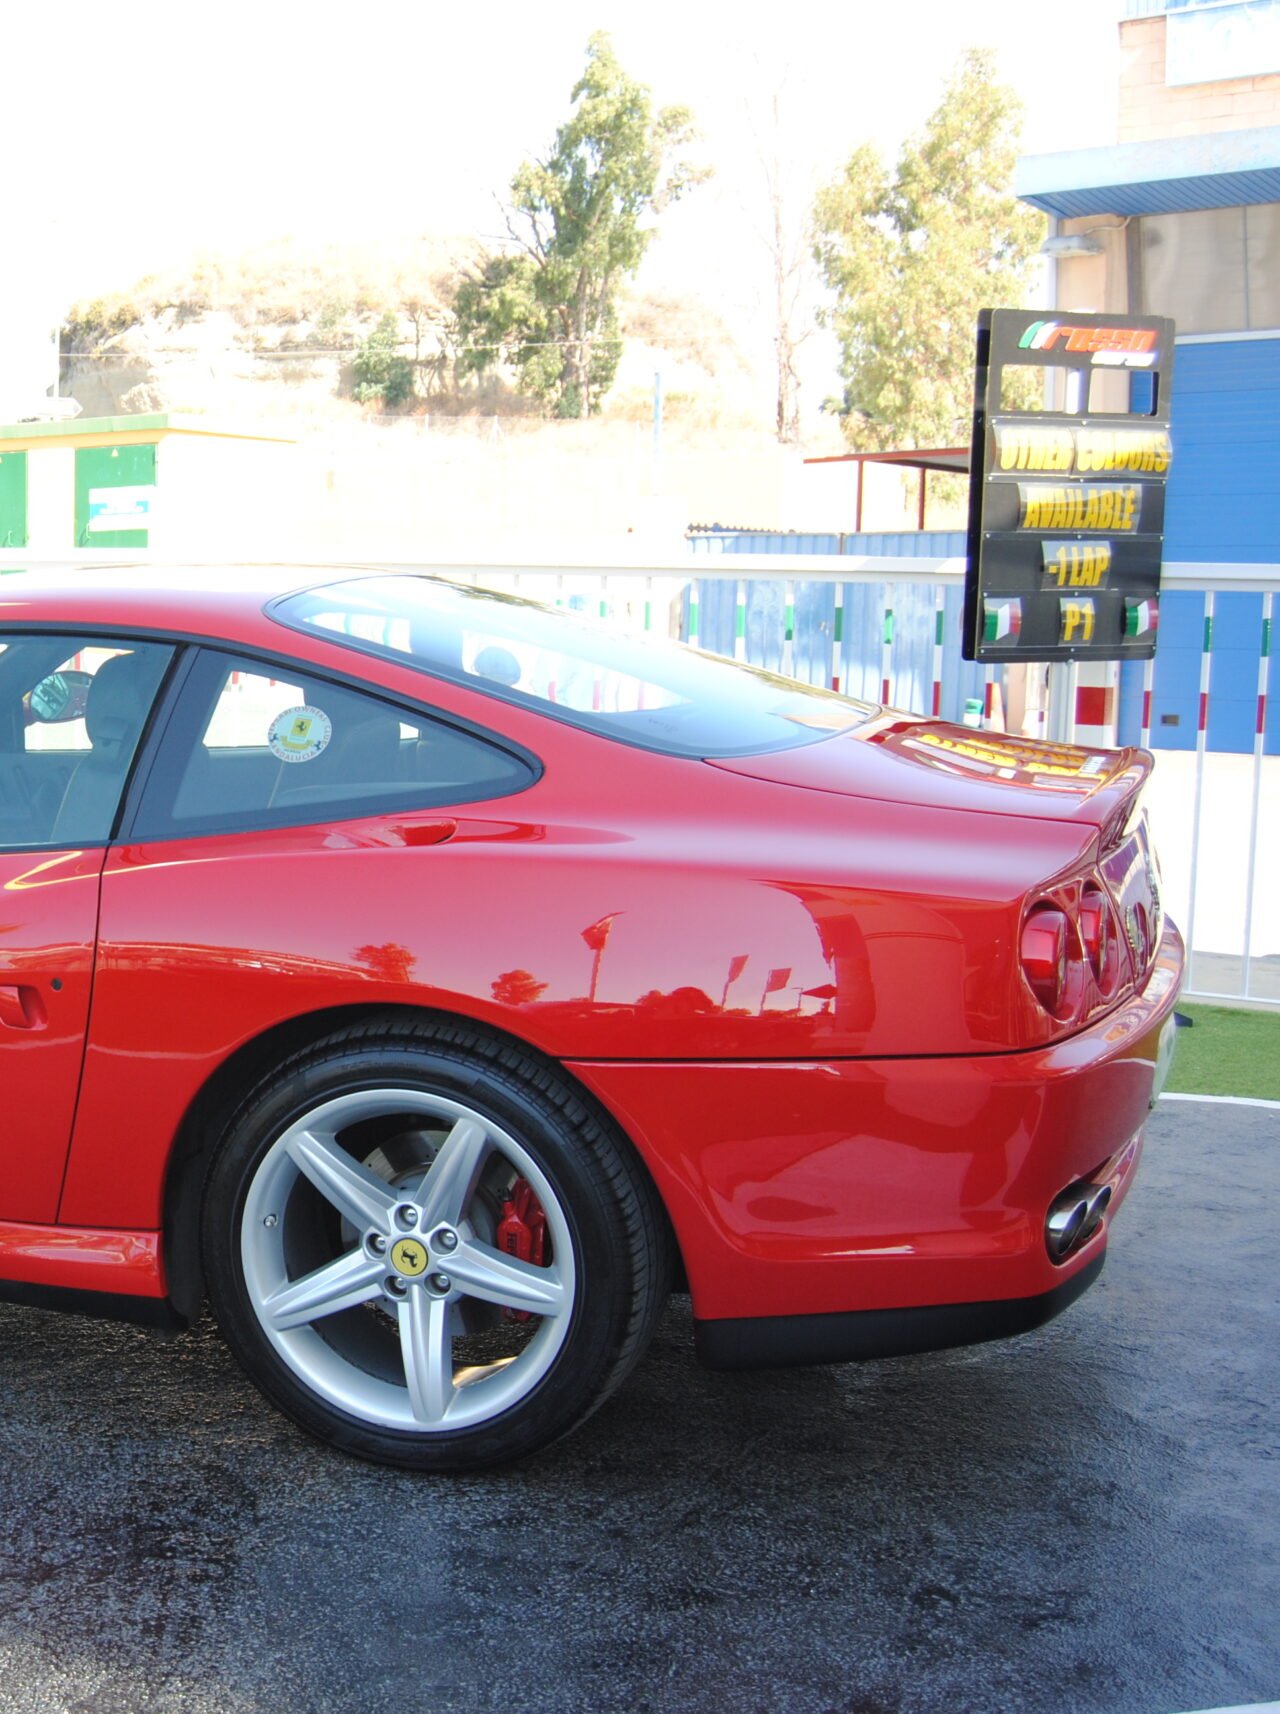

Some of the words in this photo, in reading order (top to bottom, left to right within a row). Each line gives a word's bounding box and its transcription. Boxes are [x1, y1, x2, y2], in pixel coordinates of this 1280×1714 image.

[1000, 429, 1072, 470] OTHER
[1076, 430, 1169, 473] COLOURS
[1022, 488, 1136, 530] AVAILABLE
[1048, 546, 1067, 586] -1
[1068, 546, 1109, 586] LAP
[1063, 602, 1092, 641] P1
[271, 742, 318, 761] ANDALUCIA
